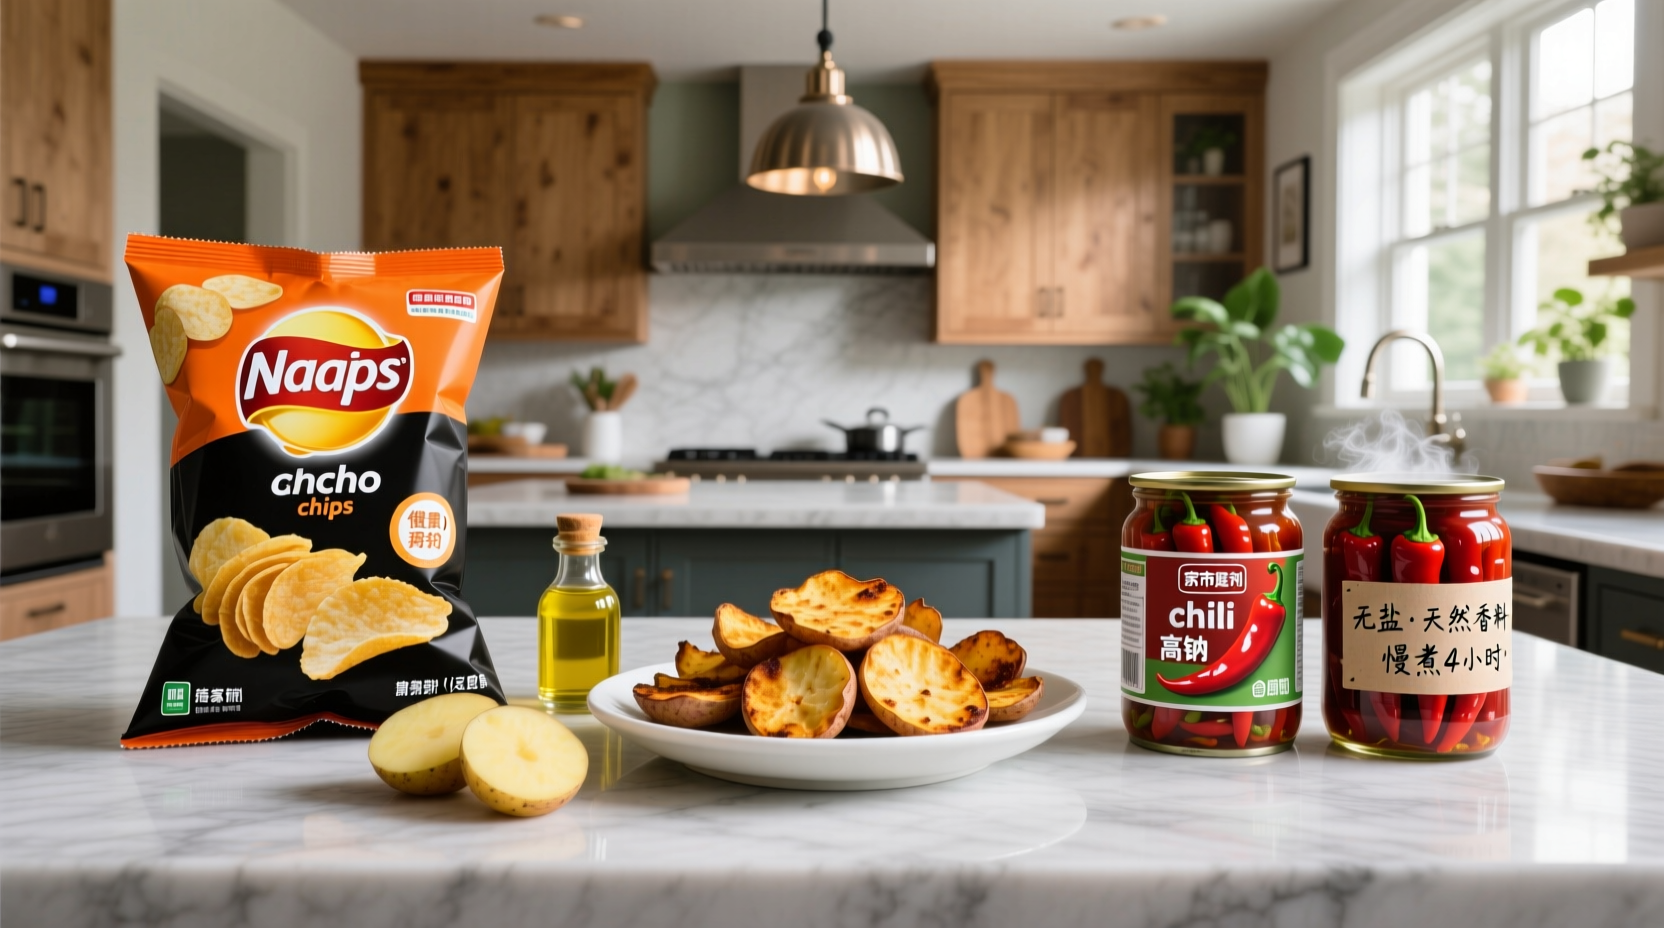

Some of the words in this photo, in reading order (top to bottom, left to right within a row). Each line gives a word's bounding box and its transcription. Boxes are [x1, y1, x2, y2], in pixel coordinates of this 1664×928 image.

[297, 496, 354, 521] chips
[1168, 600, 1235, 630] chili
[1160, 634, 1208, 663] 高钠
